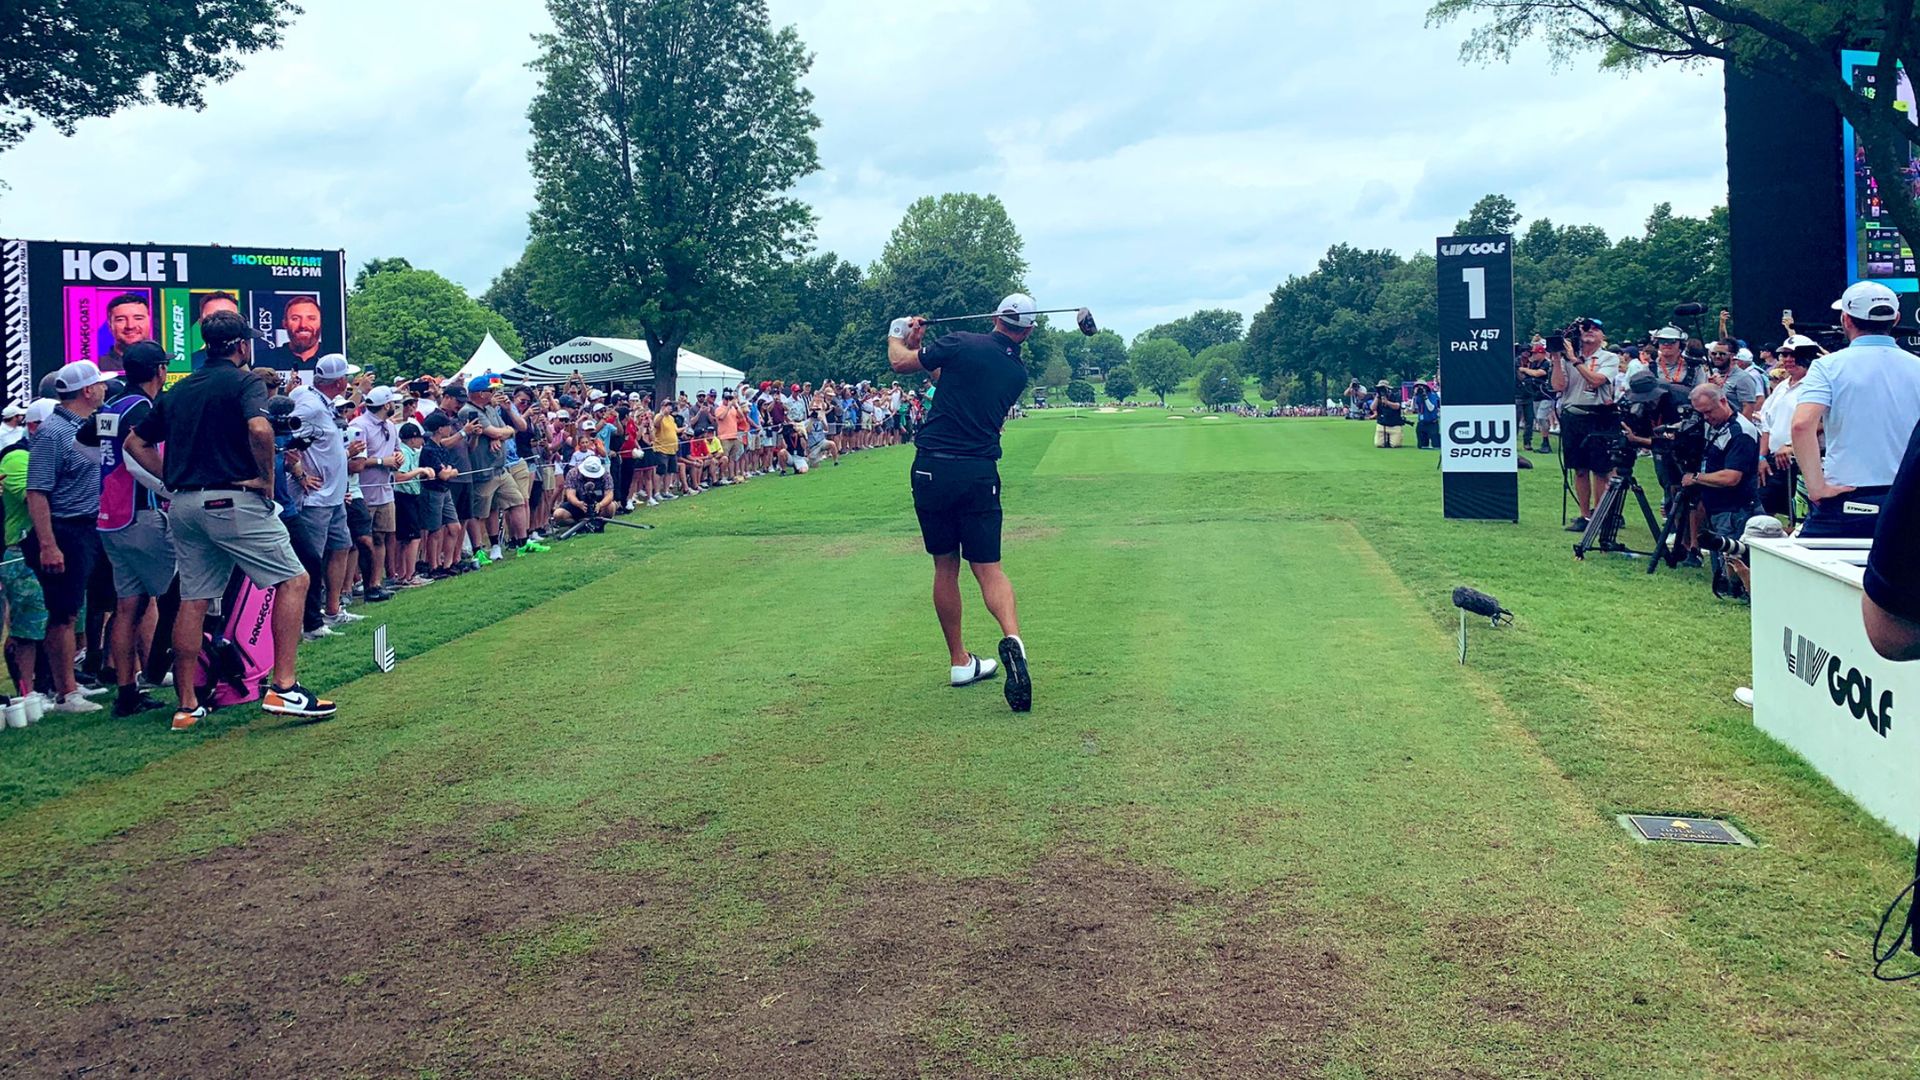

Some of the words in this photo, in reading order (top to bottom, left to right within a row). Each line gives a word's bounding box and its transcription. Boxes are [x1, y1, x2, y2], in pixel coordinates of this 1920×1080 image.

[63, 250, 166, 282] HOLE
[173, 252, 188, 282] 1
[231, 254, 289, 266] SHOTGUN
[289, 256, 322, 267] START
[271, 266, 301, 277] 12:16
[302, 267, 322, 277] PM
[1462, 267, 1486, 319] 1
[173, 305, 185, 361] STINGER
[259, 311, 276, 349] ACES
[1470, 329, 1479, 340] Y
[1480, 329, 1500, 339] 457
[1451, 341, 1478, 352] PAR
[1480, 341, 1488, 351] 4
[549, 353, 613, 365] CONCESSIONS
[1449, 421, 1510, 444] CW
[1450, 448, 1512, 458] SPORTS
[248, 587, 275, 646] RANGEGOA
